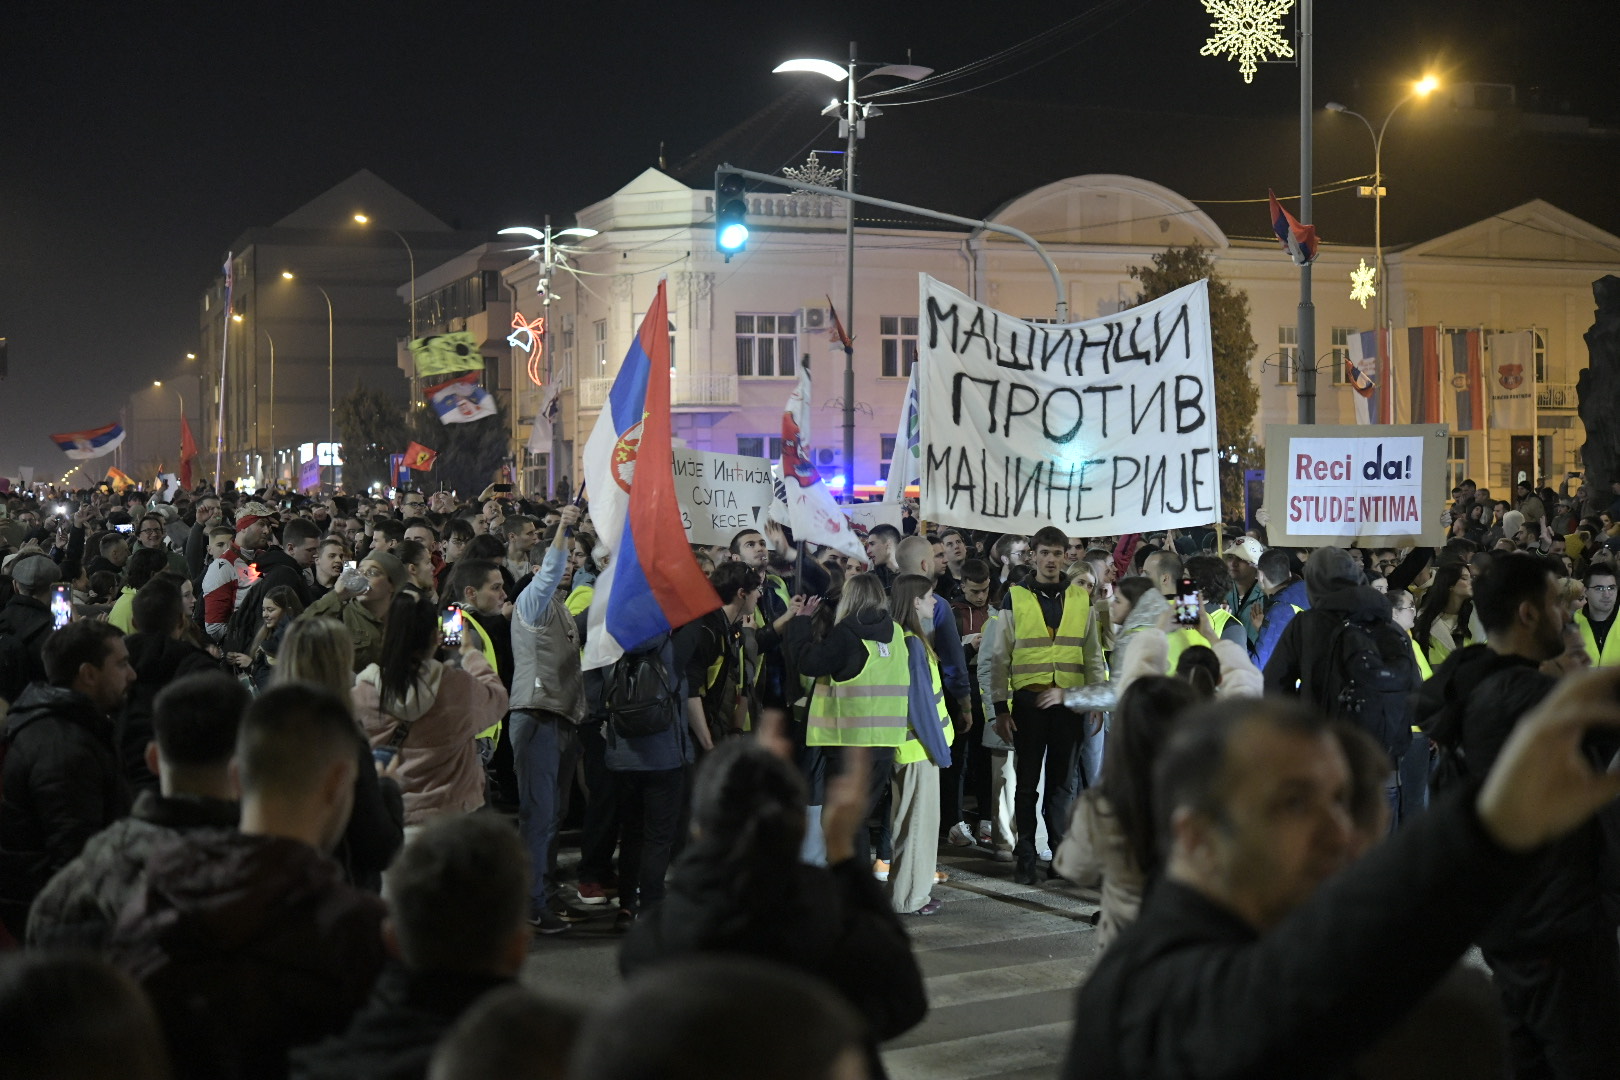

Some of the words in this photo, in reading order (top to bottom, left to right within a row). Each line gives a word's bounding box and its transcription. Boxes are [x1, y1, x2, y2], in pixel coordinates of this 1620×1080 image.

[927, 296, 1190, 376] МАШИНЦИ
[952, 372, 1206, 444] ПРОТИВ
[926, 443, 1214, 523] МАШИНЕРИЈЕ
[1295, 453, 1352, 481] Reci
[1362, 443, 1413, 480] da!
[692, 486, 737, 509] СУПА
[1289, 495, 1419, 523] STUDENTIMA
